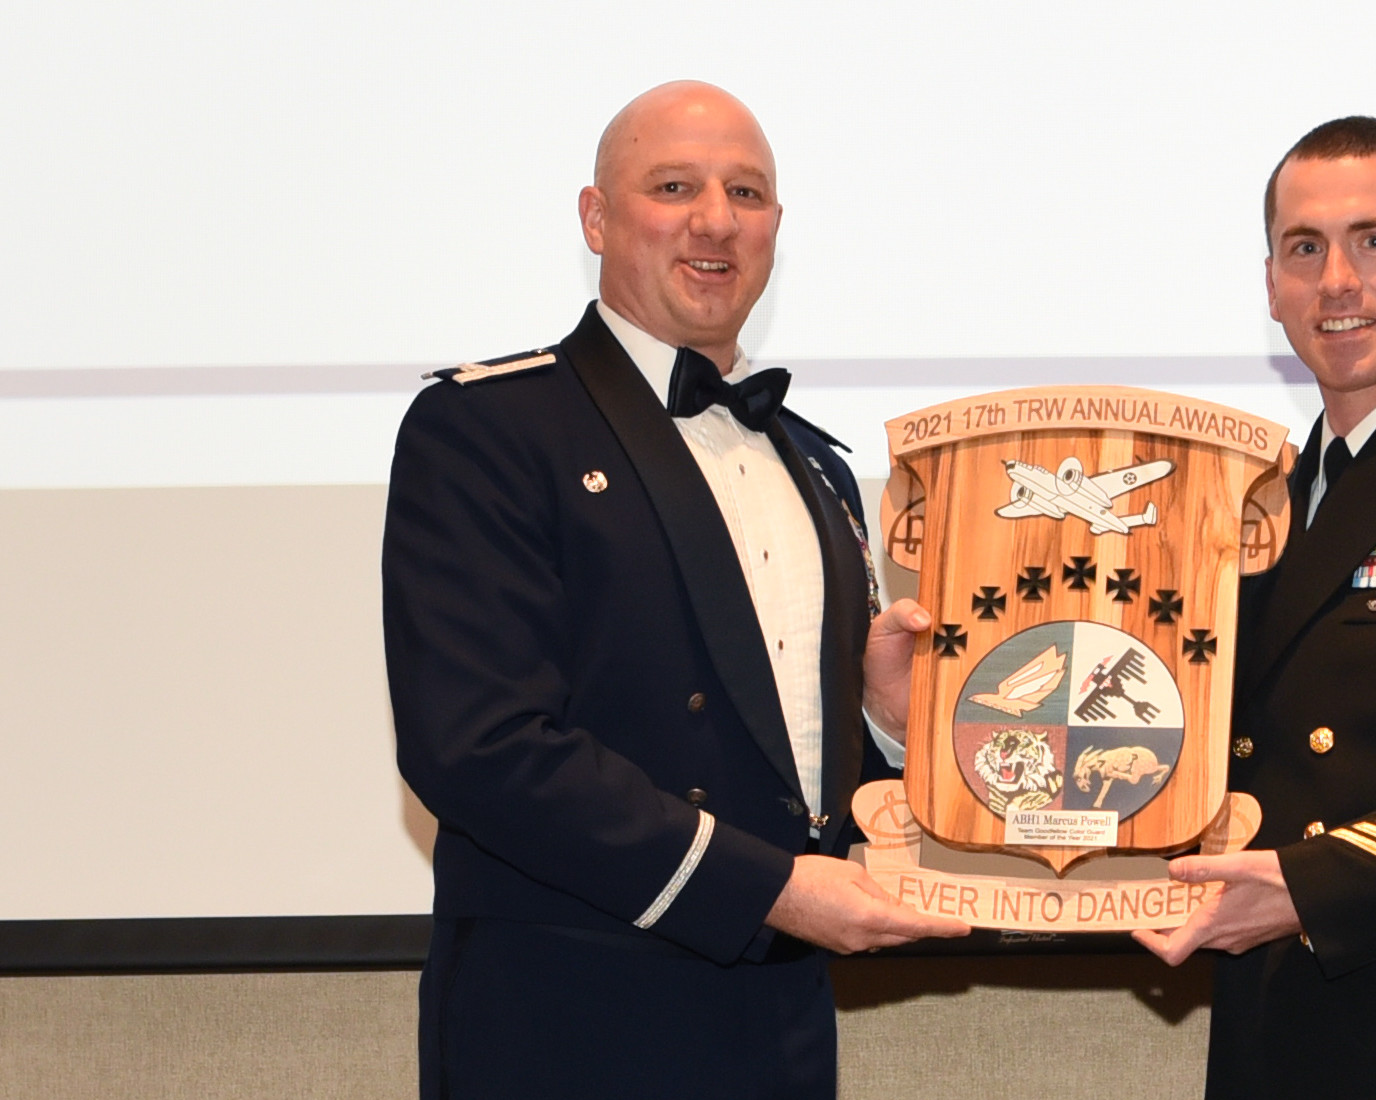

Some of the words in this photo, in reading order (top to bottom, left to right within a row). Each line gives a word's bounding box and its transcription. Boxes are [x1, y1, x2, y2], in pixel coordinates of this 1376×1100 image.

[902, 413, 952, 445] 2021
[962, 402, 1006, 430] 17th
[1013, 398, 1068, 424] TRW
[1070, 397, 1166, 427] ANNUAL
[1169, 405, 1269, 452] AWARDS
[1043, 814, 1078, 826] Marcus
[1080, 815, 1111, 827] Powell
[899, 875, 979, 918] EVER
[992, 888, 1064, 923] INTO
